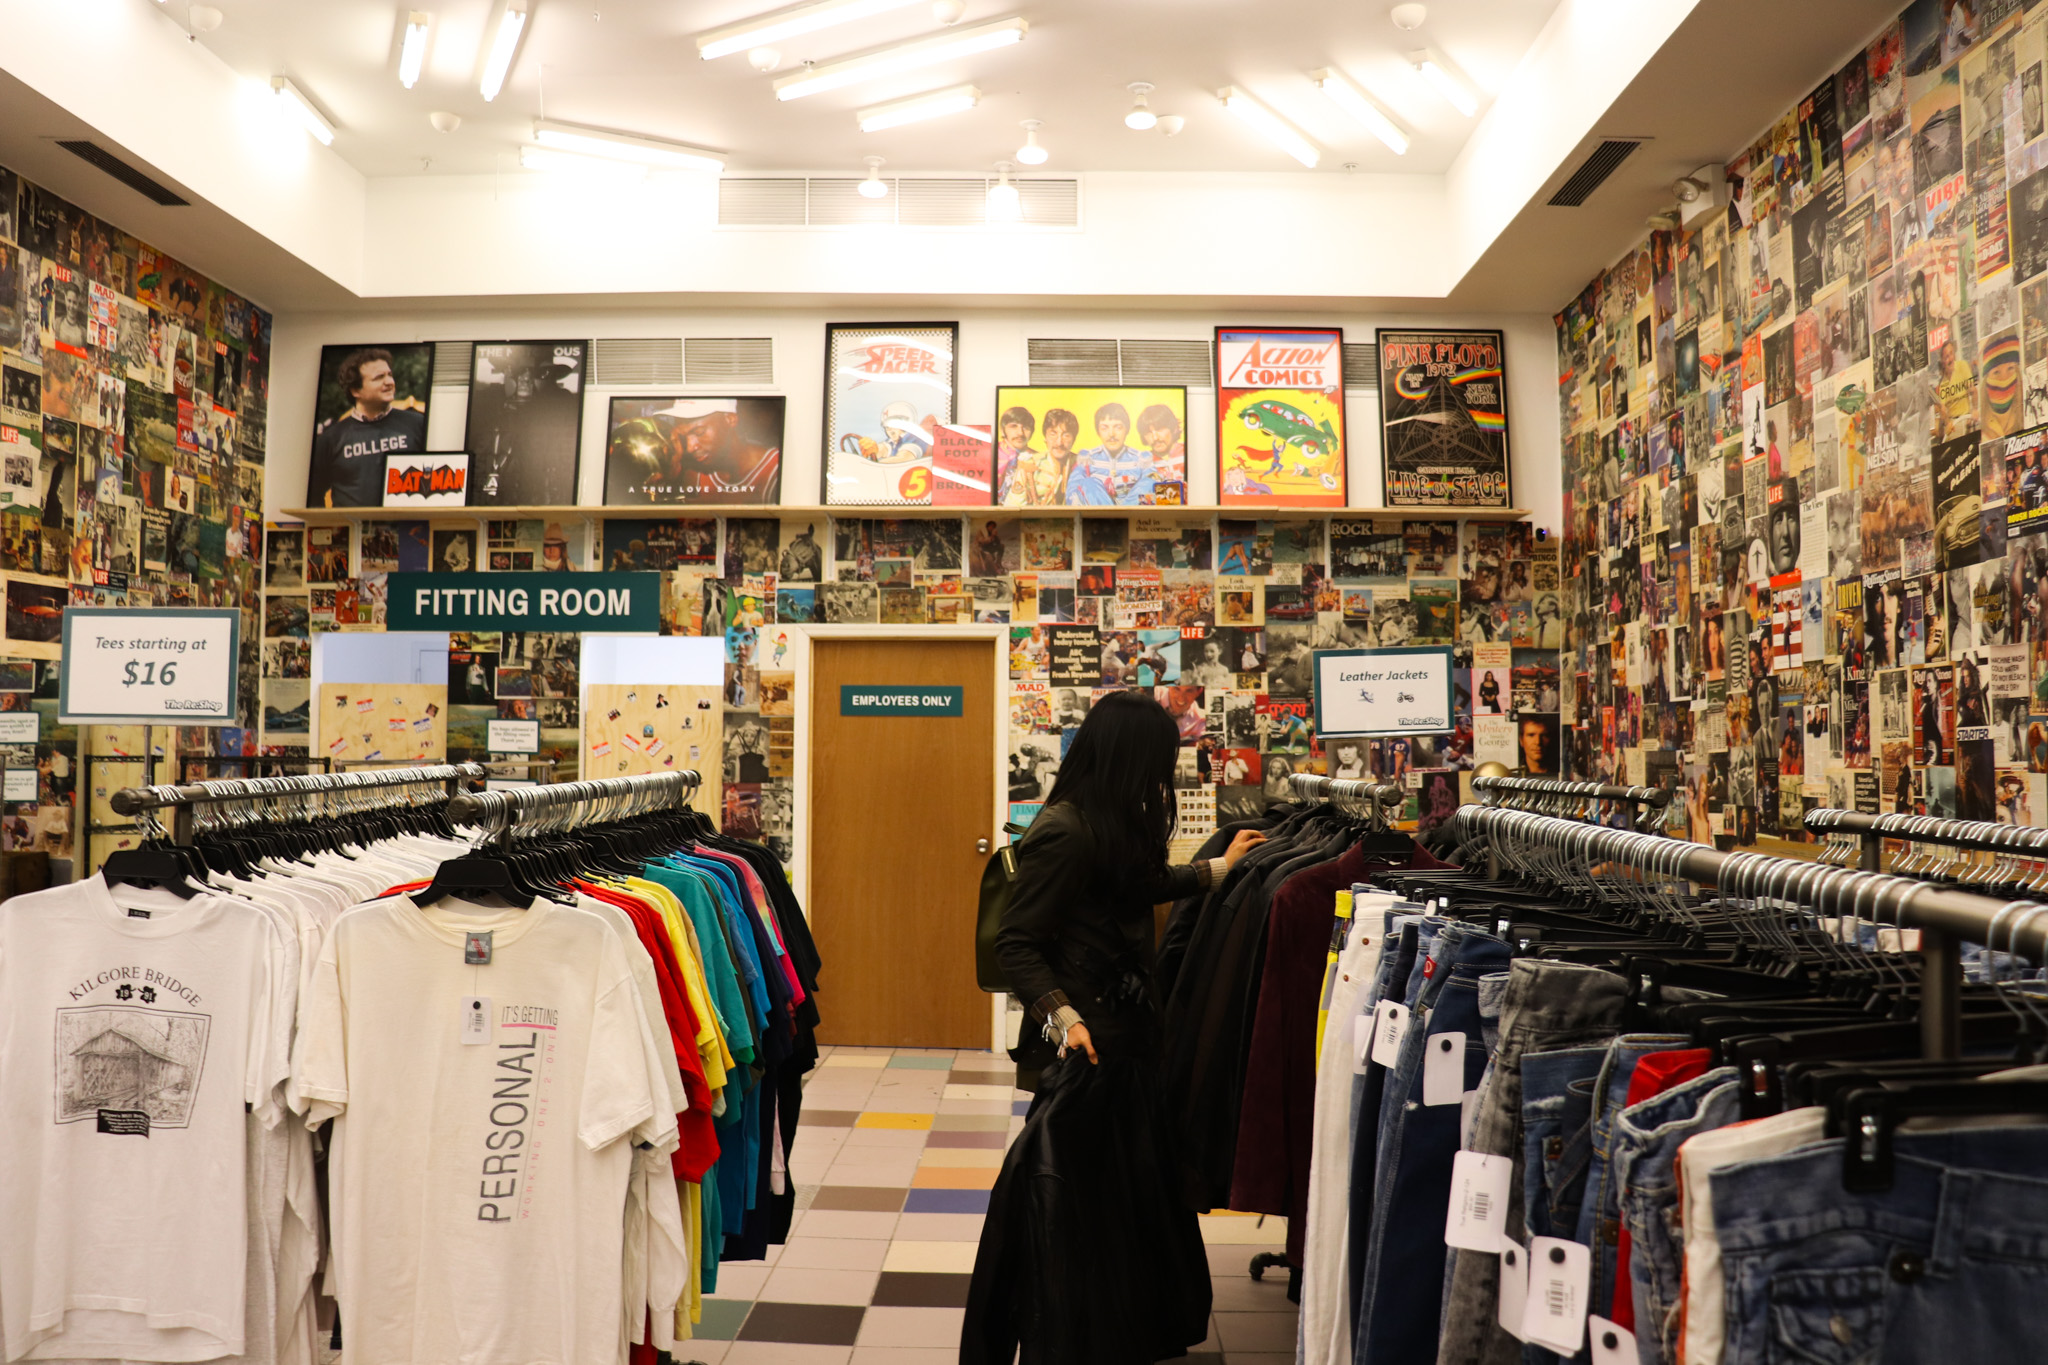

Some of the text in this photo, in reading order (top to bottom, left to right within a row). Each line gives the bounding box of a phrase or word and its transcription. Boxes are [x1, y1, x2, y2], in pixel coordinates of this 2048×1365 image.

[56, 265, 72, 282] LIFE
[94, 284, 115, 300] MAD
[1930, 325, 1948, 351] LIFE
[216, 341, 228, 356] LIFE
[480, 348, 502, 358] THE
[864, 344, 935, 364] SPEED
[1229, 336, 1337, 382] ACTION
[1384, 343, 1498, 370] PINK FLOYD
[860, 359, 938, 374] RACER
[1426, 363, 1457, 377] 1972
[1244, 370, 1323, 385] COMICS
[1466, 384, 1494, 394] NEW
[1940, 375, 1978, 400] CRONKITE
[1464, 394, 1498, 404] YORK
[15, 410, 40, 421] CONCERT
[2, 426, 18, 443] LIFE
[344, 435, 408, 458] COLLEGE
[940, 438, 983, 446] BLACK
[1874, 431, 1898, 454] FULL
[2006, 431, 2042, 456] RACING
[944, 450, 980, 458] FOOT
[1867, 447, 1899, 470] NELSON
[642, 486, 672, 494] TRUE
[679, 486, 710, 494] LOVE
[716, 486, 756, 494] STORY
[905, 469, 927, 498] 5
[936, 482, 976, 490] BRO
[1389, 470, 1504, 498] LIVE ON STAGE
[1769, 485, 1782, 502] LIFE
[1331, 523, 1372, 536] ROCK
[94, 570, 109, 584] LIFE
[1116, 578, 1140, 588] olling
[1864, 570, 1900, 589] Rolling Stone
[416, 588, 631, 616] FITTING ROOM
[1120, 602, 1160, 610] MOMENTS
[1181, 627, 1204, 638] LIFE
[95, 636, 208, 654] Tees starting at
[1054, 656, 1098, 664] Evening News
[1070, 649, 1083, 657] ABC
[122, 658, 178, 689] $16
[1052, 670, 1070, 678] Frank
[1068, 663, 1084, 671] with
[1992, 664, 2004, 672] COLD
[1340, 670, 1428, 682] Leather Jackets
[1913, 670, 1926, 685] Roll
[1016, 684, 1045, 692] MAD
[164, 699, 224, 712] The Re:Shop
[852, 695, 952, 707] EMPLOYEES ONLY
[1398, 716, 1444, 726] The Re:Shop
[1478, 724, 1513, 735] Mystery
[1956, 728, 1989, 740] STARTER
[1478, 738, 1510, 748] George
[69, 966, 202, 1008] KILGORE BRIDGE
[120, 989, 130, 998] 19
[144, 990, 153, 1000] 91
[502, 1006, 519, 1022] IT'S
[521, 1006, 558, 1026] GETTING
[478, 1032, 538, 1224] PERSONAL
[522, 1032, 557, 1220] WORKING ONE-2-ONE
